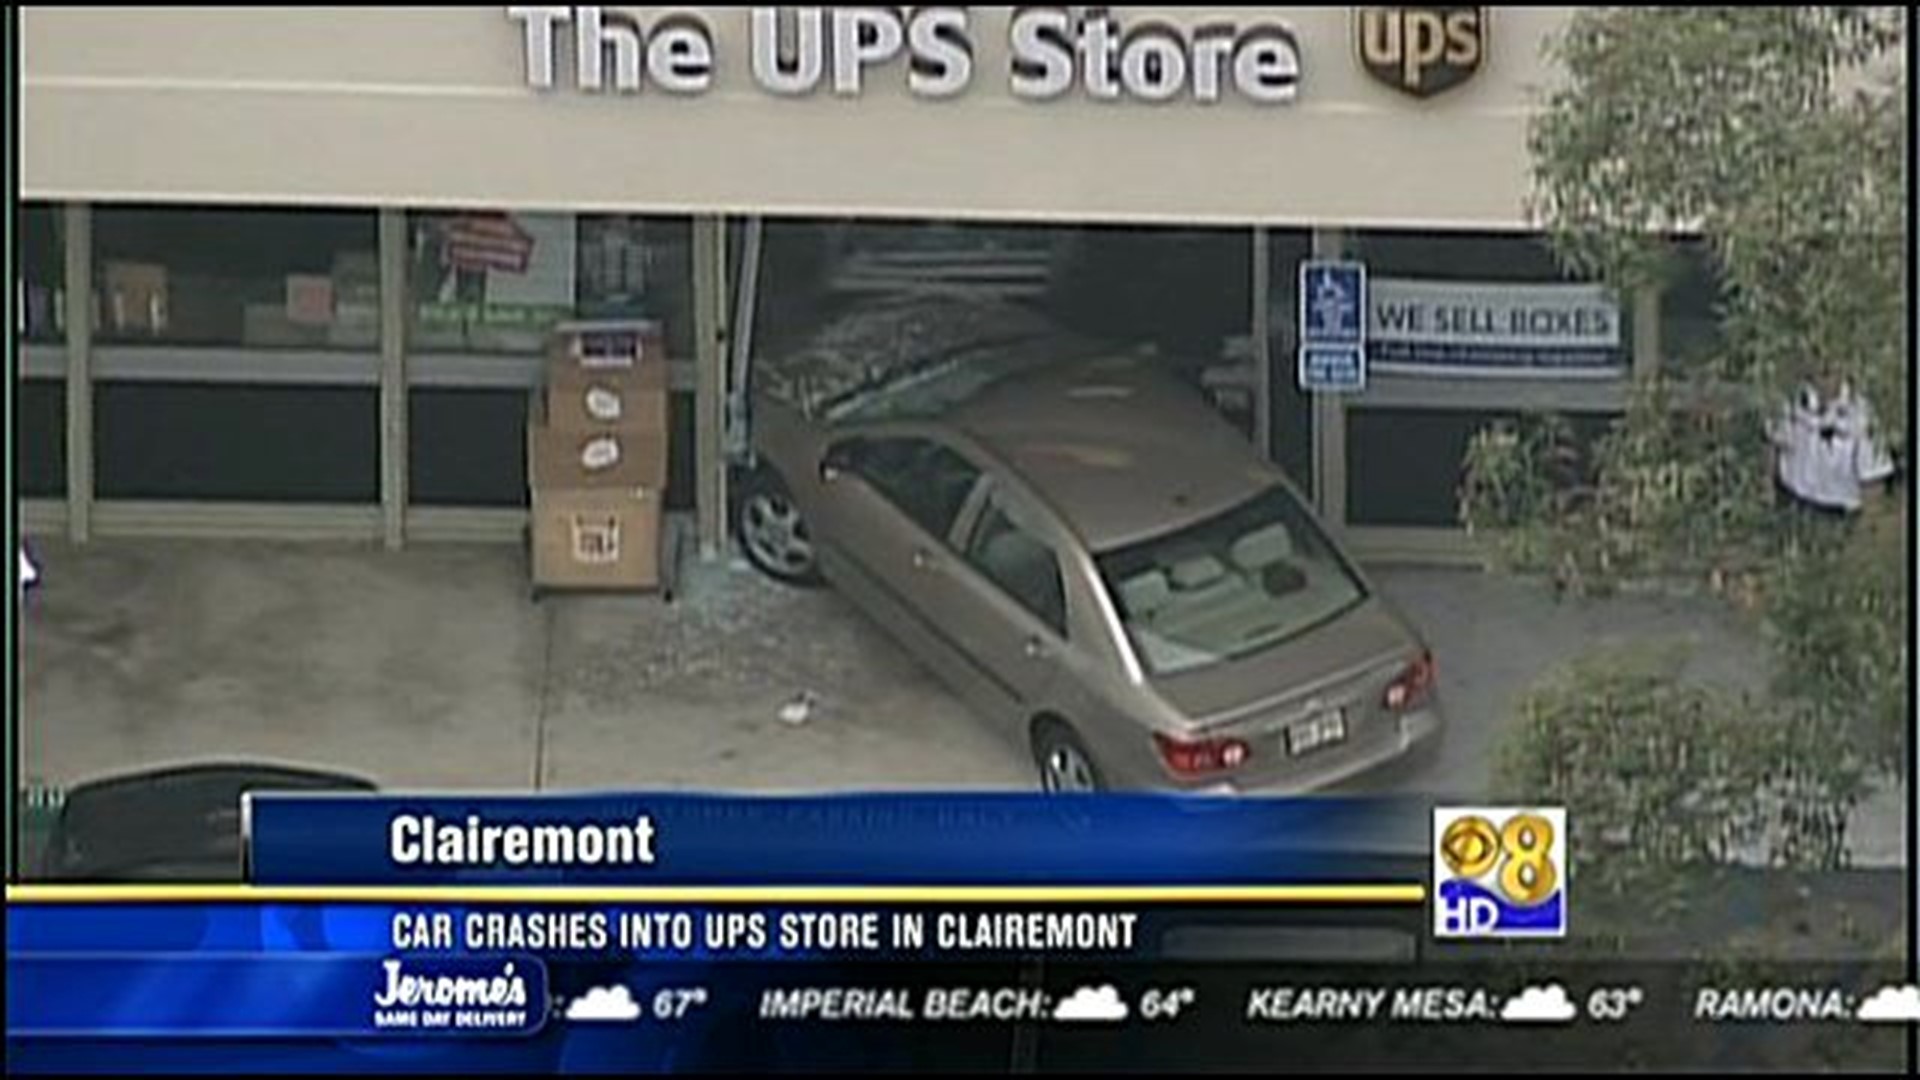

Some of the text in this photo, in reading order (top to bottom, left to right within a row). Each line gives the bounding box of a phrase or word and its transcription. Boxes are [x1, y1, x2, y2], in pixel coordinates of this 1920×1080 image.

[508, 6, 1299, 101] The UPS Store
[1362, 7, 1478, 87] ups
[1377, 302, 1611, 337] WE SELL BOXES
